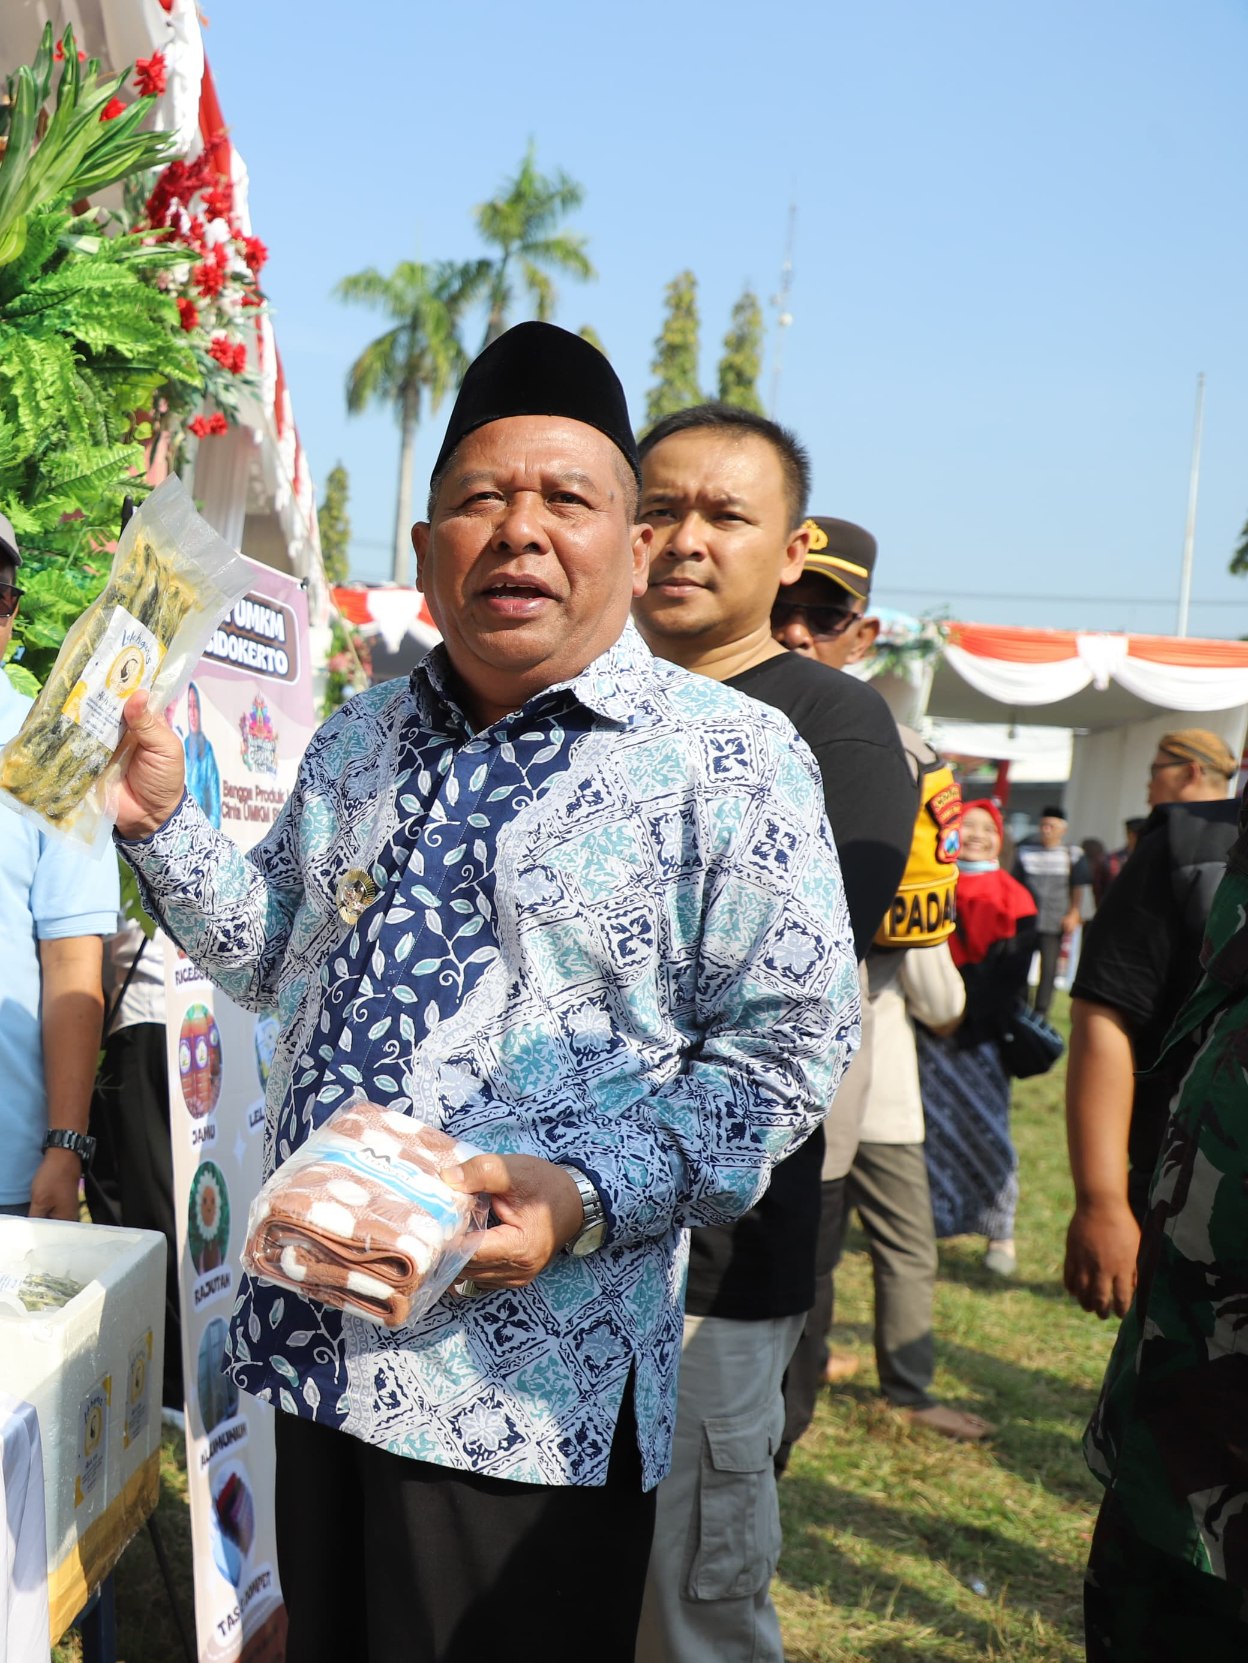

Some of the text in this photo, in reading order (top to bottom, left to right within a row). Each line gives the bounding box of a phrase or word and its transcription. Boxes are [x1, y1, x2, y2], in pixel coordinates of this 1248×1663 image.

[233, 598, 286, 642] UMKM
[890, 883, 957, 937] PADA
[249, 1107, 265, 1127] LEL
[192, 1125, 215, 1145] JAMU
[194, 1272, 230, 1305] RAJUTAN
[217, 1605, 240, 1636] TAS
